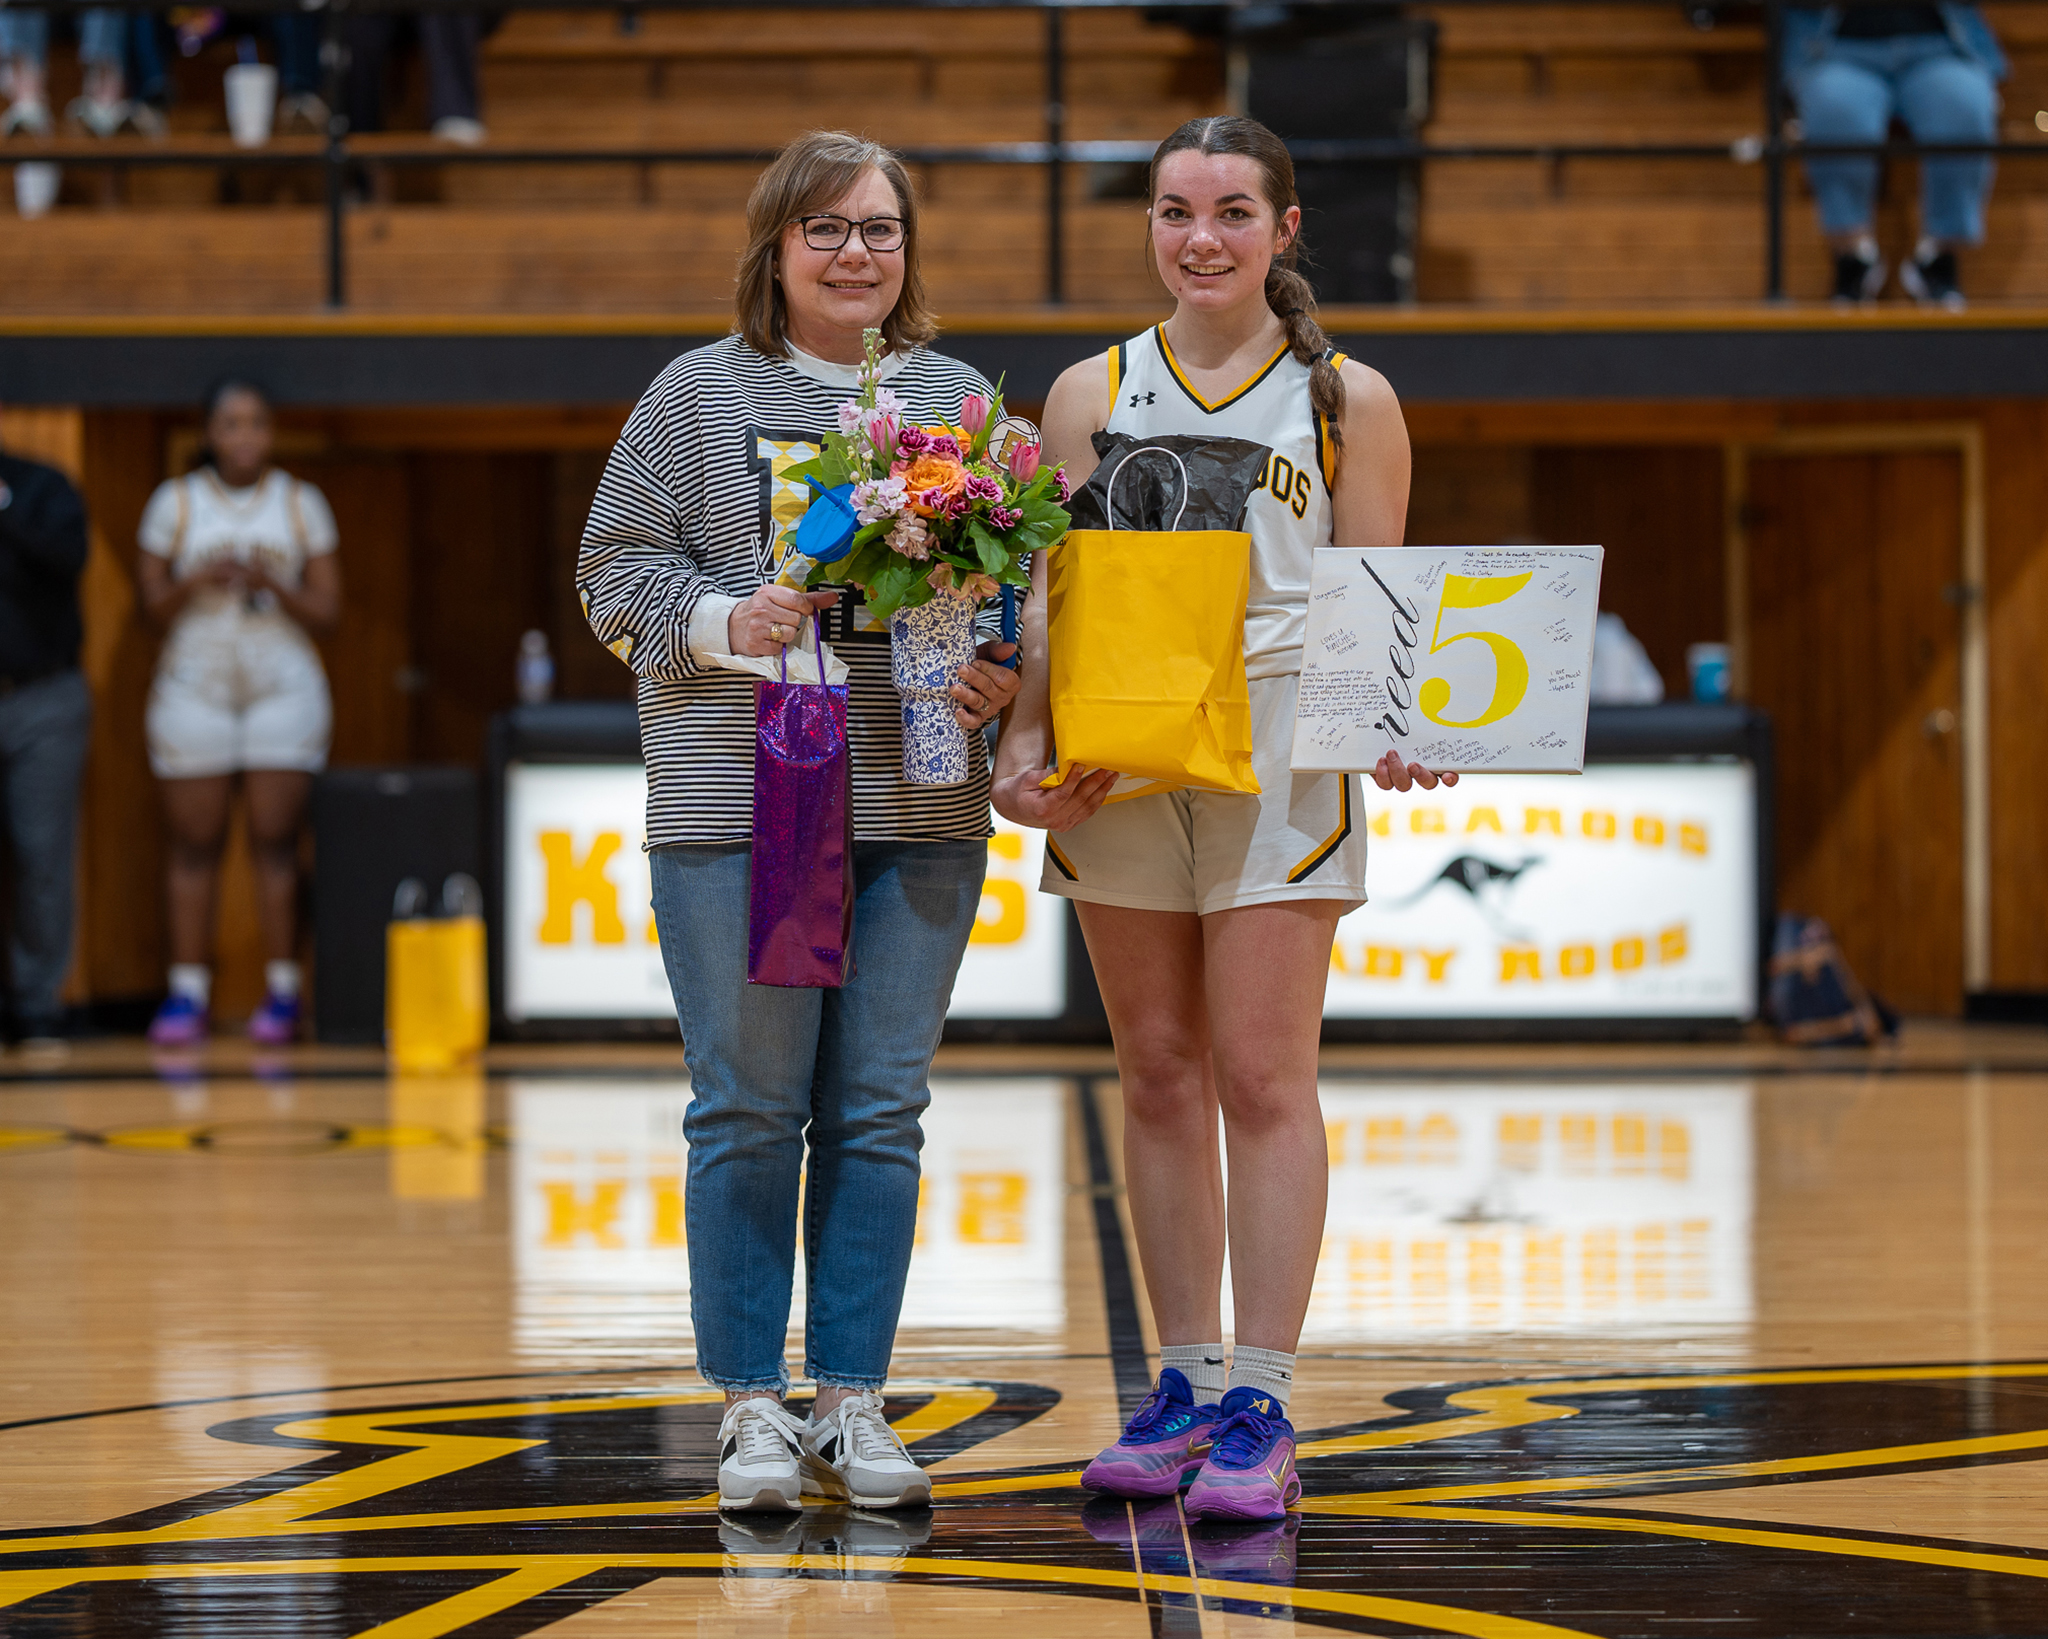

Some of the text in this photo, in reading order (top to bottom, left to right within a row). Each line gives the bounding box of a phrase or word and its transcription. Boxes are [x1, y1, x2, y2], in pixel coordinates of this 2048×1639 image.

[1325, 630, 1357, 653] BUNCHES
[1361, 557, 1420, 744] reed
[1419, 571, 1533, 729] 5
[1421, 743, 1436, 754] wish
